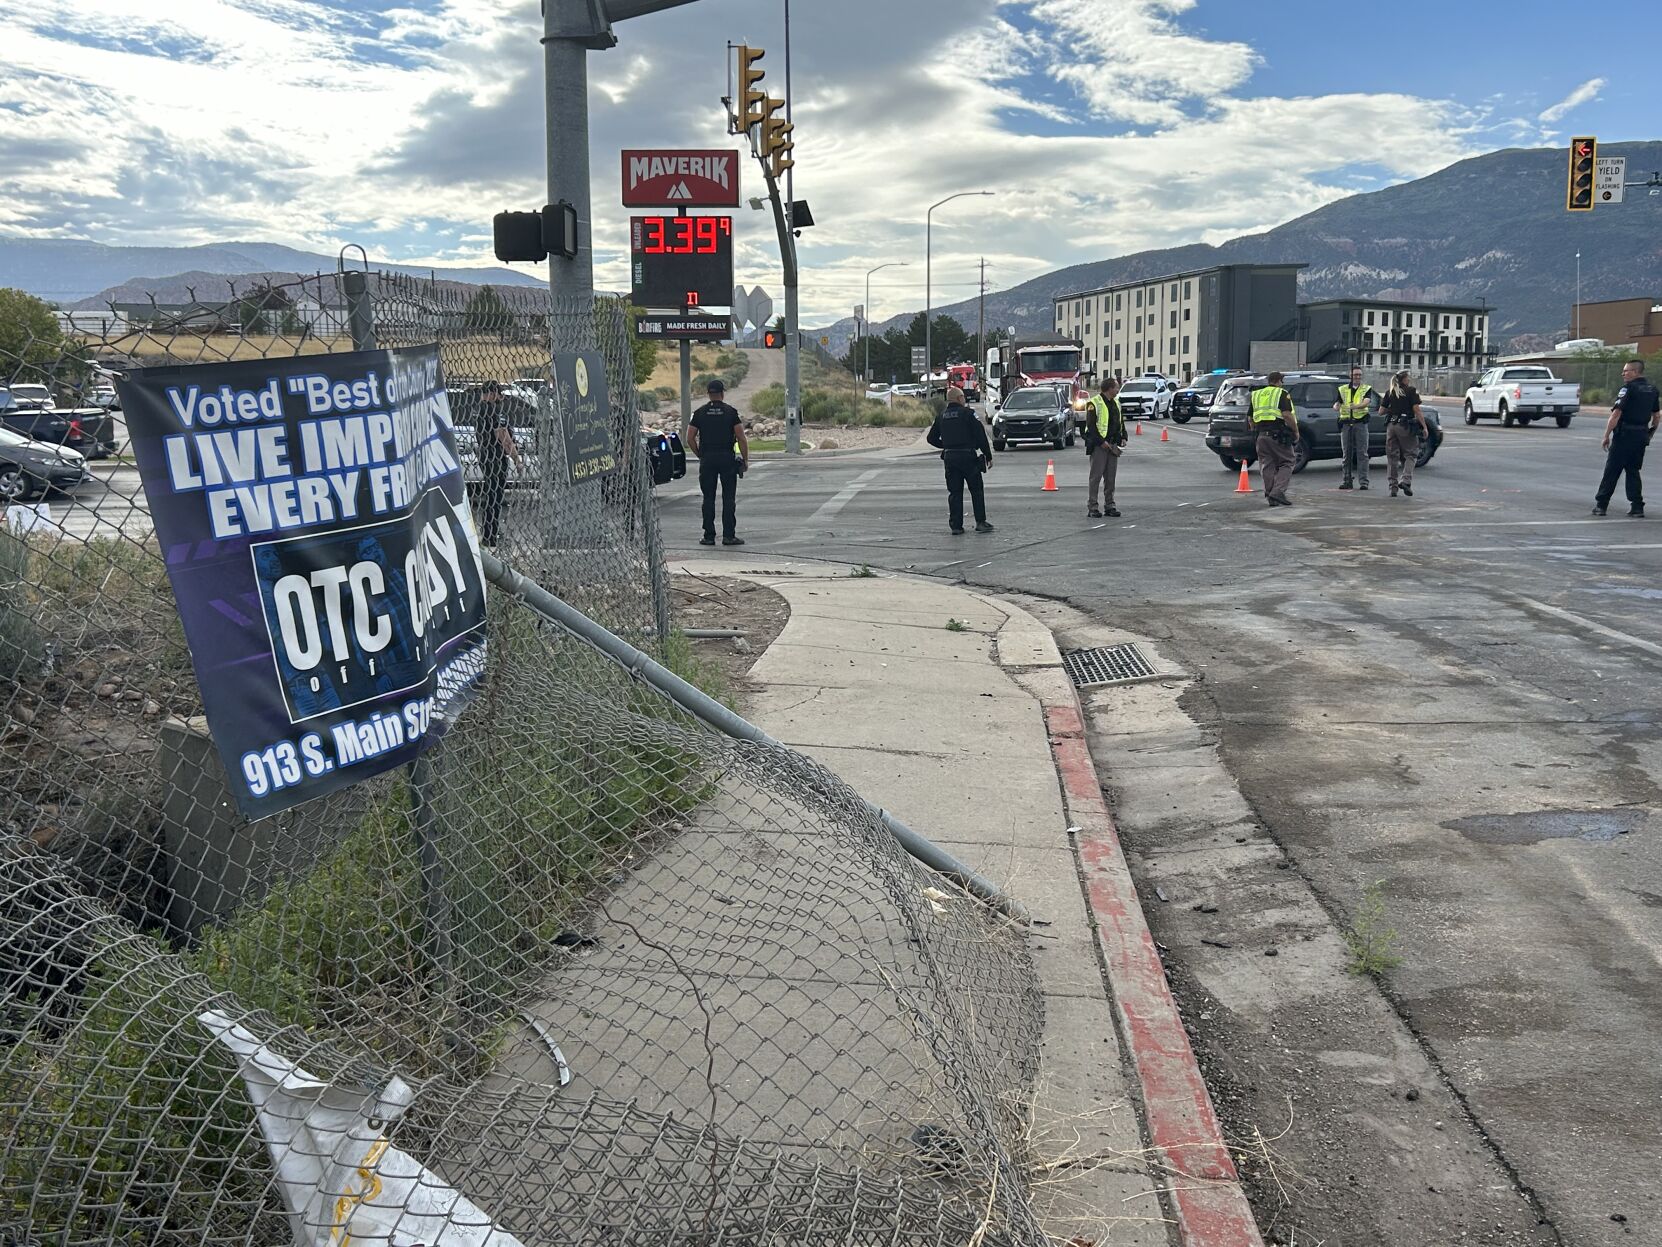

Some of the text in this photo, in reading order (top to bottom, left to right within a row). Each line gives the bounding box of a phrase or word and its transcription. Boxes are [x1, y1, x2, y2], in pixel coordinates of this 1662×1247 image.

[630, 157, 728, 191] MAVERIK
[1599, 166, 1620, 175] YIELD
[666, 322, 727, 330] MADE FRESH DAILY
[170, 379, 282, 427] Voted
[289, 372, 380, 414] "Best
[167, 426, 287, 490] LIVE
[210, 474, 358, 539] EVERY
[370, 454, 417, 512] FRI
[273, 560, 392, 672] OTC
[243, 741, 299, 796] 913
[304, 733, 333, 777] S.
[335, 712, 404, 768] Main
